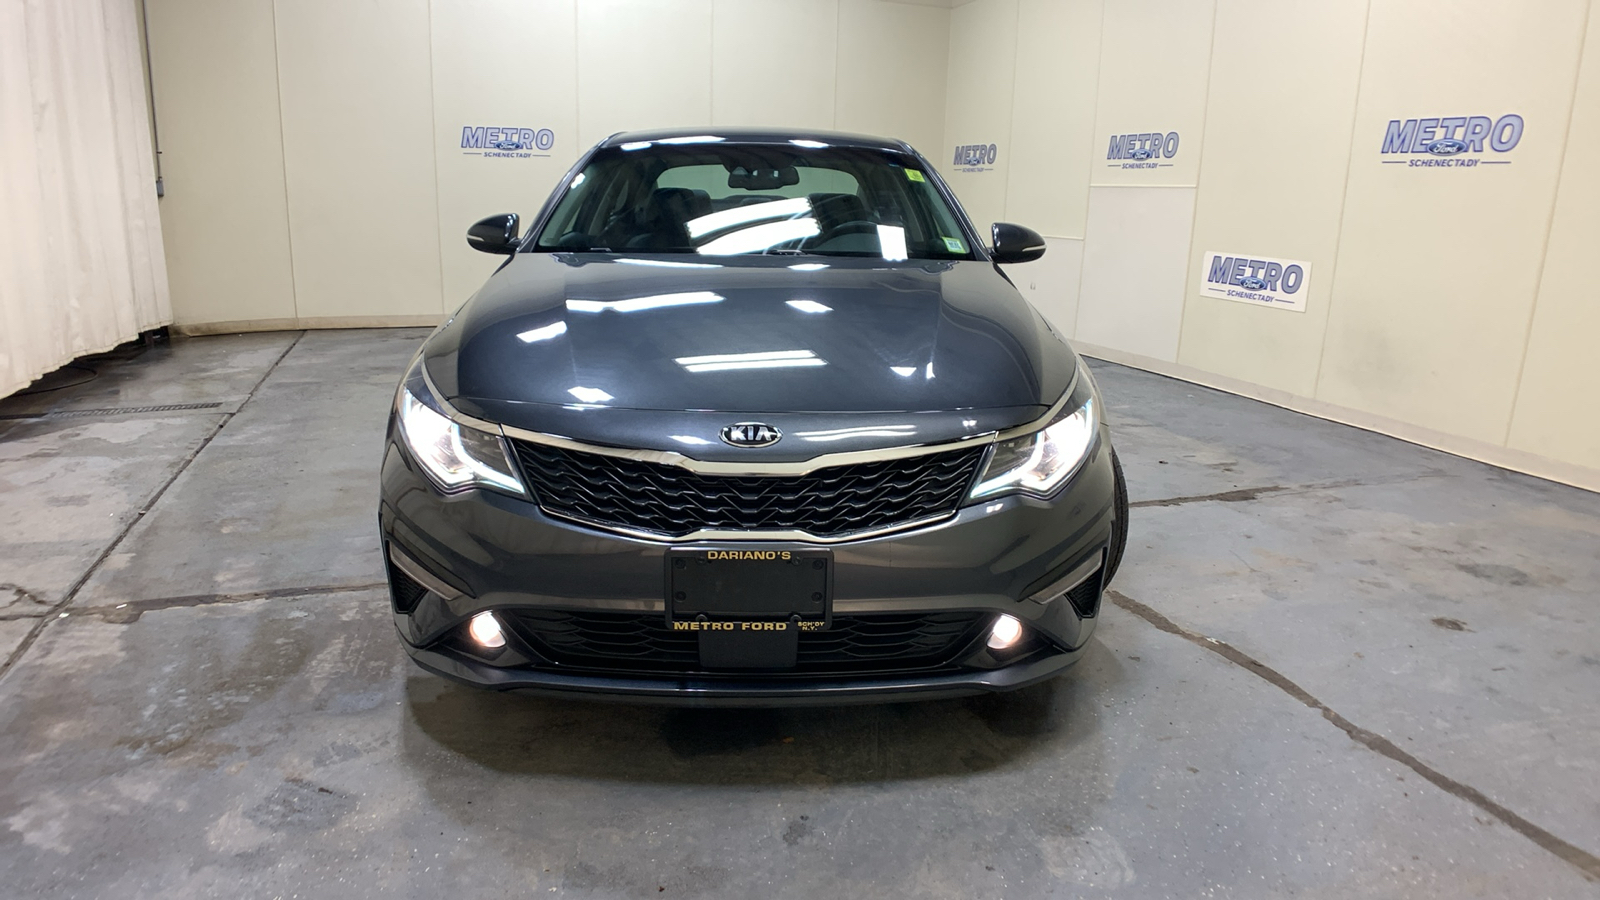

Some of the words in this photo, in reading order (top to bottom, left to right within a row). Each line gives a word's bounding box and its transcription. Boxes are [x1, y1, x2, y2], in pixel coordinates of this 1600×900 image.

[461, 126, 554, 150] METRO
[1381, 114, 1524, 153] METRO
[953, 143, 997, 165] METRO
[1107, 131, 1179, 159] METRO
[1408, 158, 1480, 167] SCHENECTADY
[1207, 255, 1304, 294] METRO
[1226, 289, 1275, 303] SCHENECTADY
[730, 426, 772, 441] KIA
[707, 551, 791, 560] DARIANO'S
[673, 621, 734, 631] METRO
[741, 621, 787, 631] FORD
